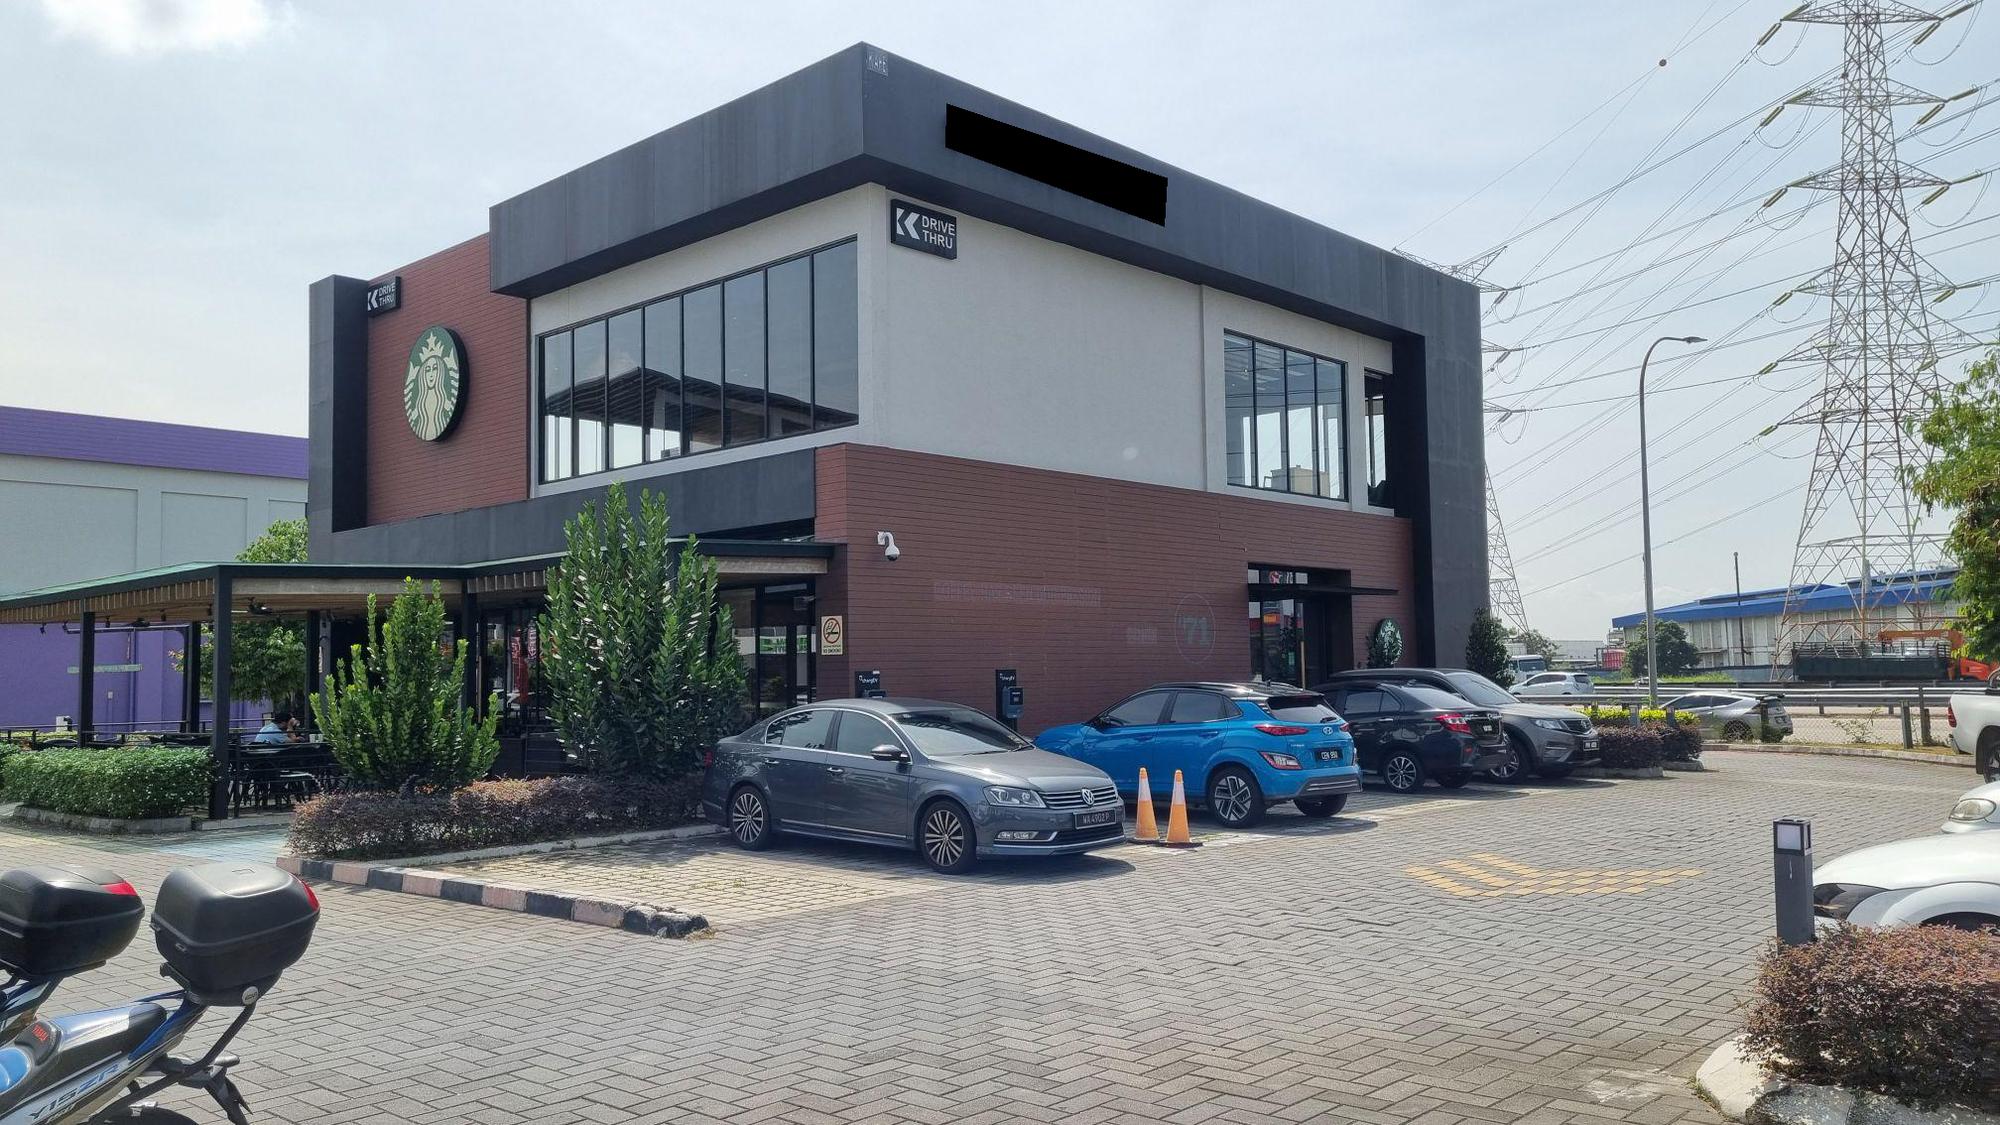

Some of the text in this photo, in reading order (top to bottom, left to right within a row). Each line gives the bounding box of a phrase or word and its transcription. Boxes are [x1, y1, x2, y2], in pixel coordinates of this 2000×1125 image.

[922, 215, 955, 236] DRIVE
[922, 229, 953, 249] THRU
[379, 282, 395, 297] DRIVE
[379, 295, 395, 306] THRU
